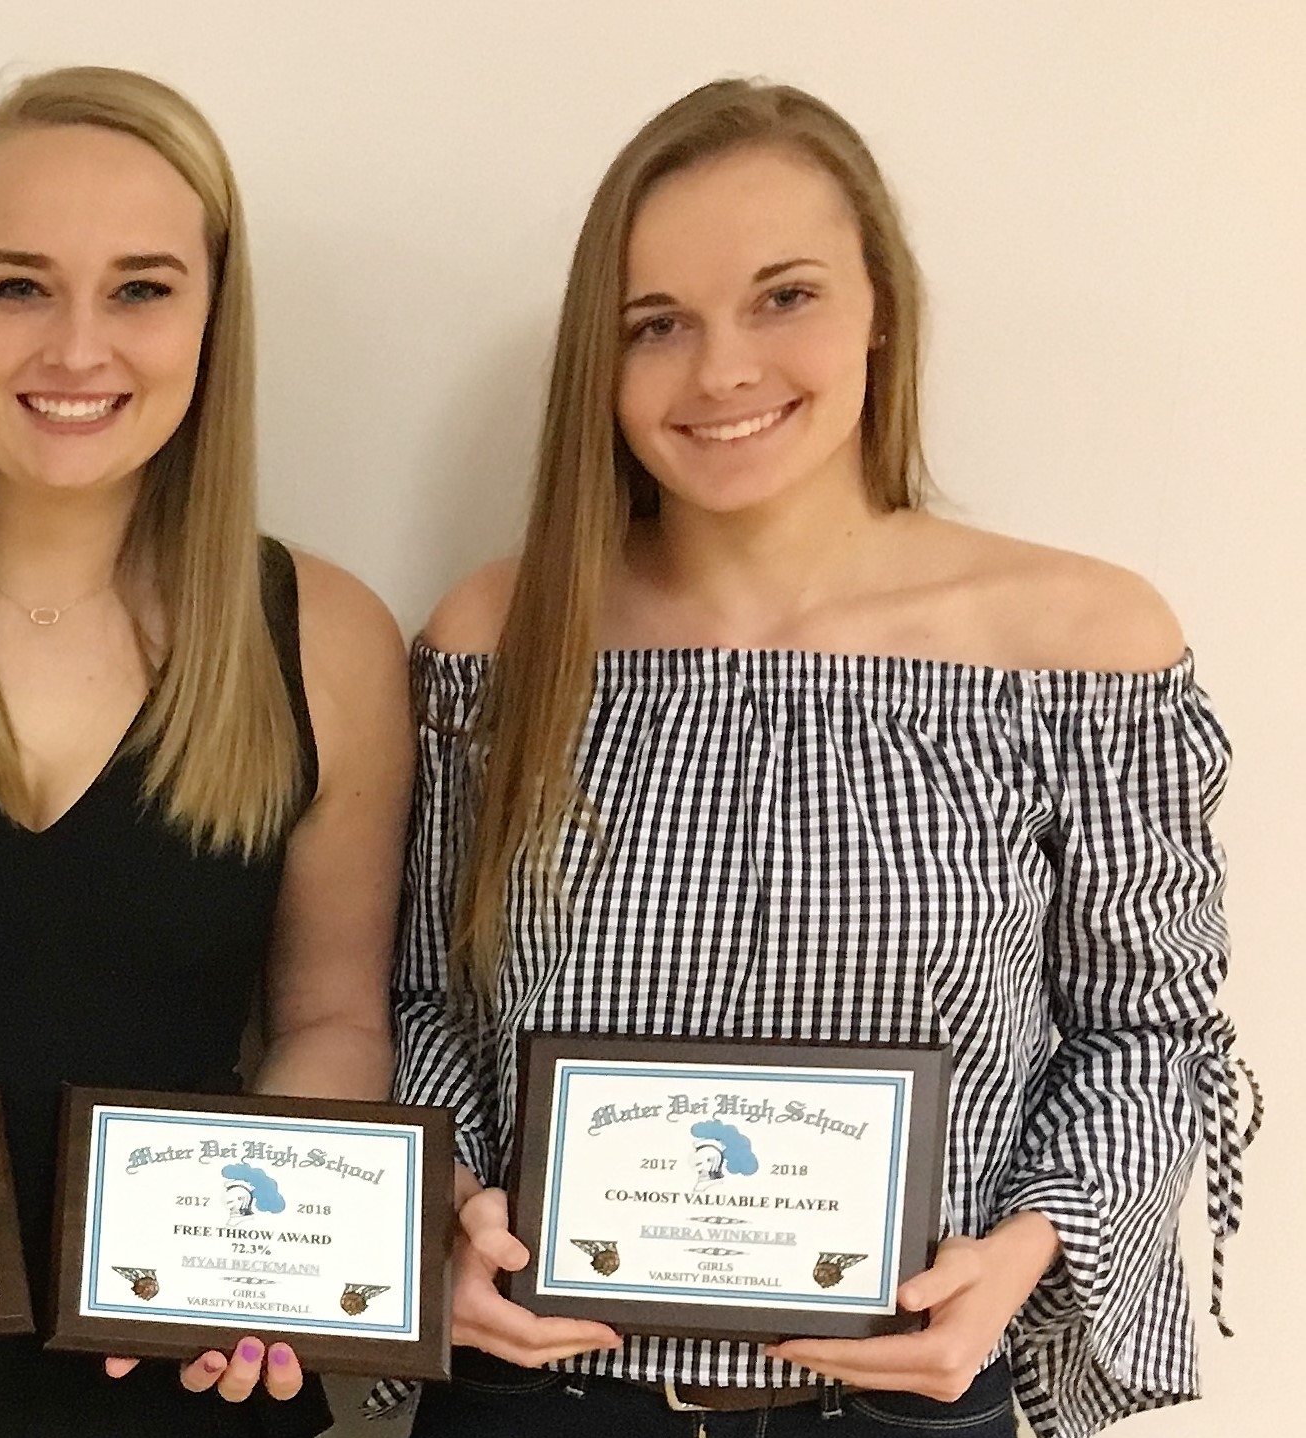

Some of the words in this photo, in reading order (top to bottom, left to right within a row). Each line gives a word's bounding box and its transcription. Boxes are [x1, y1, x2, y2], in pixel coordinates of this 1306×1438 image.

[588, 1104, 663, 1136] Mater
[667, 1094, 709, 1123] Dei
[713, 1094, 775, 1124] High
[775, 1100, 870, 1141] School
[126, 1146, 194, 1175] Mater
[198, 1139, 238, 1164] Dei
[241, 1140, 298, 1168] High
[299, 1148, 385, 1185] School
[640, 1158, 678, 1171] 2017
[770, 1163, 809, 1176] 2018
[175, 1195, 211, 1207] 2017
[604, 1189, 680, 1204] CO-MOST
[683, 1193, 770, 1208] VALUABLE
[774, 1197, 840, 1211] PLAYER
[297, 1203, 332, 1216] 2018
[173, 1224, 212, 1237] FREE
[216, 1227, 275, 1241] THROW
[277, 1232, 332, 1245] AWARD
[640, 1225, 703, 1240] KIERRA
[707, 1229, 797, 1245] WINKELER
[231, 1242, 272, 1256] 72.3%
[182, 1255, 228, 1269] MYAH
[231, 1259, 320, 1276] BECKMANN
[698, 1261, 733, 1272] GIRLS
[649, 1271, 700, 1283] VARSITY
[702, 1274, 782, 1287] BASKETBALL
[232, 1288, 266, 1299] GIRLS
[186, 1296, 235, 1308] VARSITY
[237, 1300, 312, 1314] BASKETBALL
